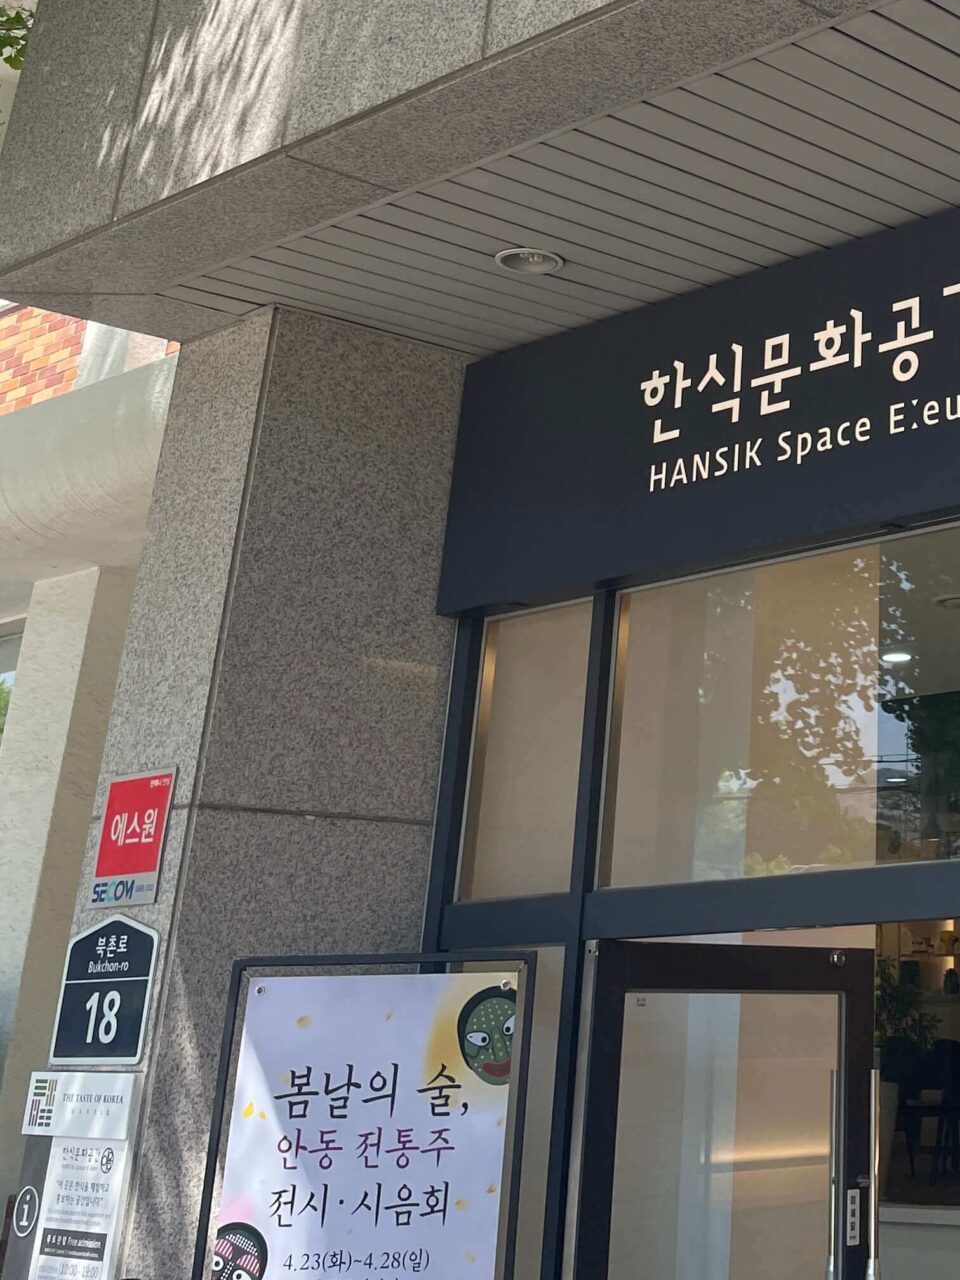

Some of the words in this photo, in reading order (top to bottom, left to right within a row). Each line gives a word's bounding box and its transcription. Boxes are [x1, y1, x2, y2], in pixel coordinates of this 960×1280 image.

[648, 437, 764, 493] HANSIK
[776, 413, 872, 465] Space
[110, 808, 158, 847] 에스원
[91, 879, 136, 903] SECOM
[87, 959, 129, 973] Bukchon-ro
[95, 935, 128, 958] 북촌로
[85, 990, 121, 1044] 18
[63, 1093, 74, 1103] THE
[75, 1093, 93, 1103] TASTE
[94, 1094, 102, 1104] OF
[103, 1094, 124, 1104] KOREA
[273, 1063, 399, 1119] 봄날의
[416, 1063, 469, 1117] 술,
[277, 1128, 343, 1170] 안동
[355, 1126, 455, 1170] 전통주
[269, 1181, 449, 1228] 전시·시음회
[283, 1248, 430, 1272] 4.23(화)~4.28(일)
